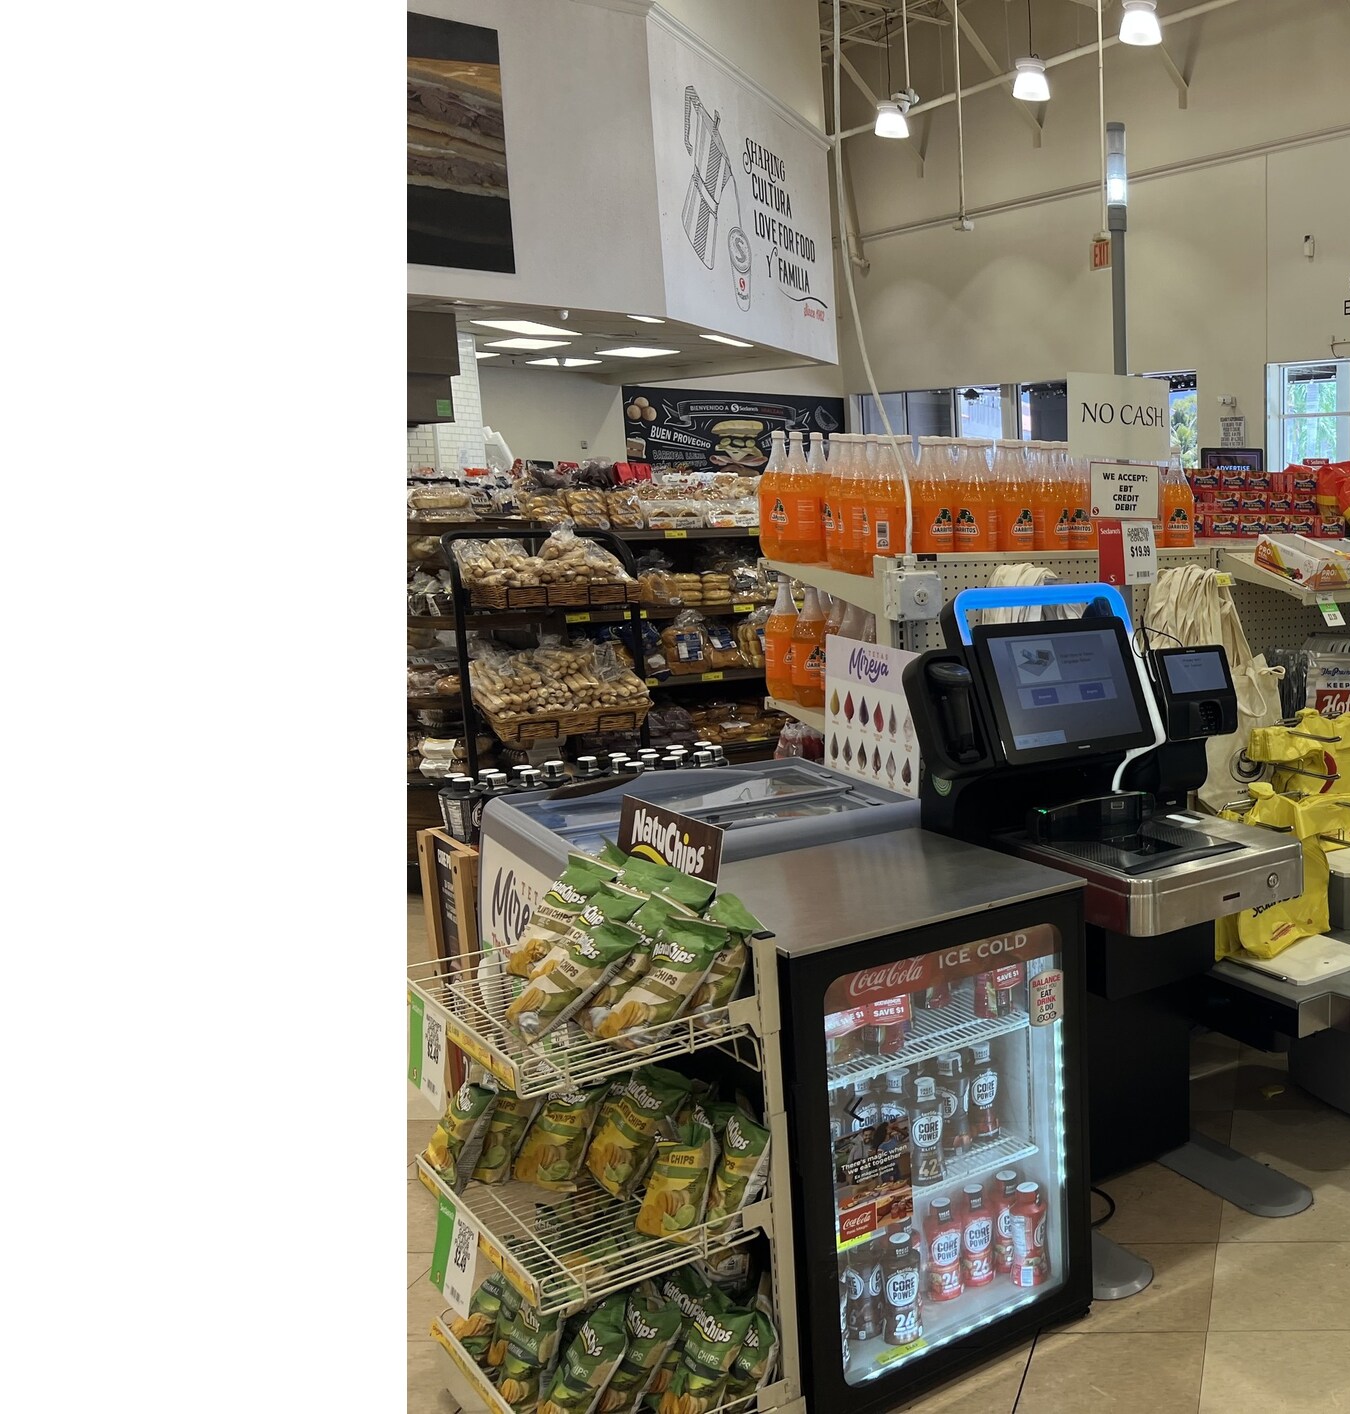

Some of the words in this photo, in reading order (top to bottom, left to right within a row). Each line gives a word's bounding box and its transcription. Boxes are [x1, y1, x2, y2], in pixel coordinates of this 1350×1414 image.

[742, 137, 785, 183] SHARING
[751, 172, 792, 219] CULTURA
[754, 209, 777, 247] LOVE
[778, 223, 794, 252] FOR
[795, 233, 815, 263] FOOD
[1094, 240, 1110, 268] EXIT
[766, 246, 778, 278] Y
[778, 258, 810, 294] FAMILIA
[1081, 402, 1115, 424] NO
[1120, 404, 1164, 428] CASH
[651, 425, 672, 441] BUEN
[673, 431, 711, 449] PROVECHO
[1102, 472, 1116, 481] WE
[1118, 473, 1149, 483] ACCEPT:
[1119, 485, 1134, 493] EBT
[1112, 494, 1139, 502] CREDIT
[1115, 503, 1137, 512] DEBIT
[1130, 545, 1151, 557] $19.99
[849, 647, 889, 683] Mireya
[631, 807, 705, 875] NatuChips
[521, 881, 539, 905] TET
[492, 867, 530, 945] Mire
[552, 910, 574, 924] CHIPS
[938, 945, 970, 969] ICE
[976, 934, 1027, 958] COLD
[562, 960, 579, 977] CHIPS
[849, 955, 926, 996] Coca-Cola
[655, 970, 678, 985] CHIPS
[996, 973, 1012, 983] SAVE
[1032, 974, 1061, 988] BALANCE
[1037, 995, 1057, 1006] DRINK
[1040, 989, 1052, 998] EAT
[873, 1008, 894, 1017] SAVE
[1045, 1003, 1053, 1011] DO
[977, 1081, 995, 1093] CORE
[977, 1091, 995, 1100] POWER
[628, 1112, 647, 1130] CHIPS
[918, 1120, 939, 1134] CORE
[918, 1131, 939, 1142] POWER
[670, 1154, 694, 1165] CHIPS
[841, 1159, 867, 1171] There's
[867, 1152, 888, 1163] magic
[888, 1144, 908, 1155] when
[848, 1167, 858, 1175] we
[860, 1164, 872, 1172] eat
[872, 1152, 902, 1167] together
[919, 1159, 939, 1177] 42
[969, 1225, 990, 1239] CORE
[937, 1238, 957, 1253] CORE
[969, 1235, 990, 1248] POWER
[454, 1247, 467, 1273] $2.49
[937, 1249, 957, 1261] POWER
[973, 1258, 989, 1276] 26
[892, 1278, 915, 1291] CORE
[942, 1271, 958, 1287] 26
[663, 1281, 700, 1318] NatuChip
[892, 1290, 915, 1300] POWER
[895, 1310, 914, 1328] 26
[697, 1350, 719, 1365] CHIPS
